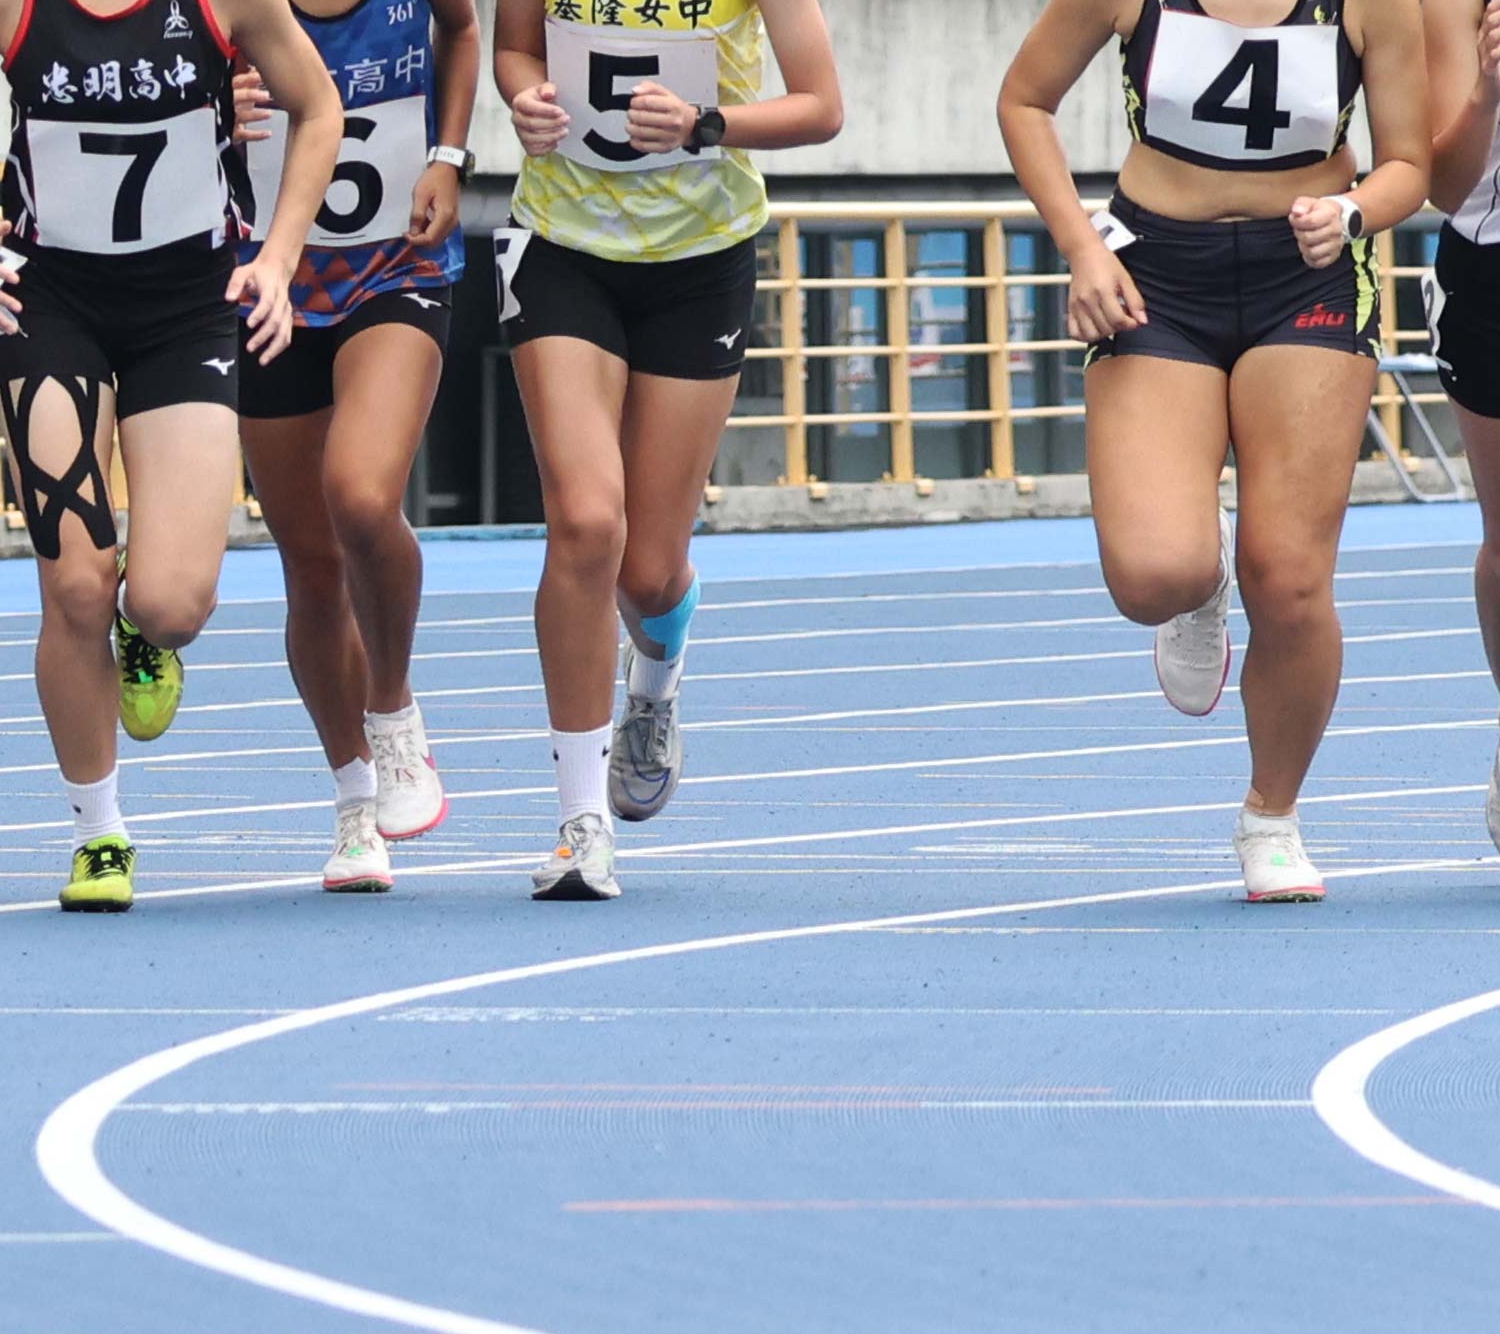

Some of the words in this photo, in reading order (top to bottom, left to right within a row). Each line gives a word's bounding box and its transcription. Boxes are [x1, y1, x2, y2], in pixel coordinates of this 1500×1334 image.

[41, 54, 197, 104] 忠明高中
[329, 44, 425, 101] 高中
[582, 50, 661, 162] 5
[1192, 39, 1291, 150] 4
[78, 130, 168, 242] 7
[314, 116, 384, 235] 6
